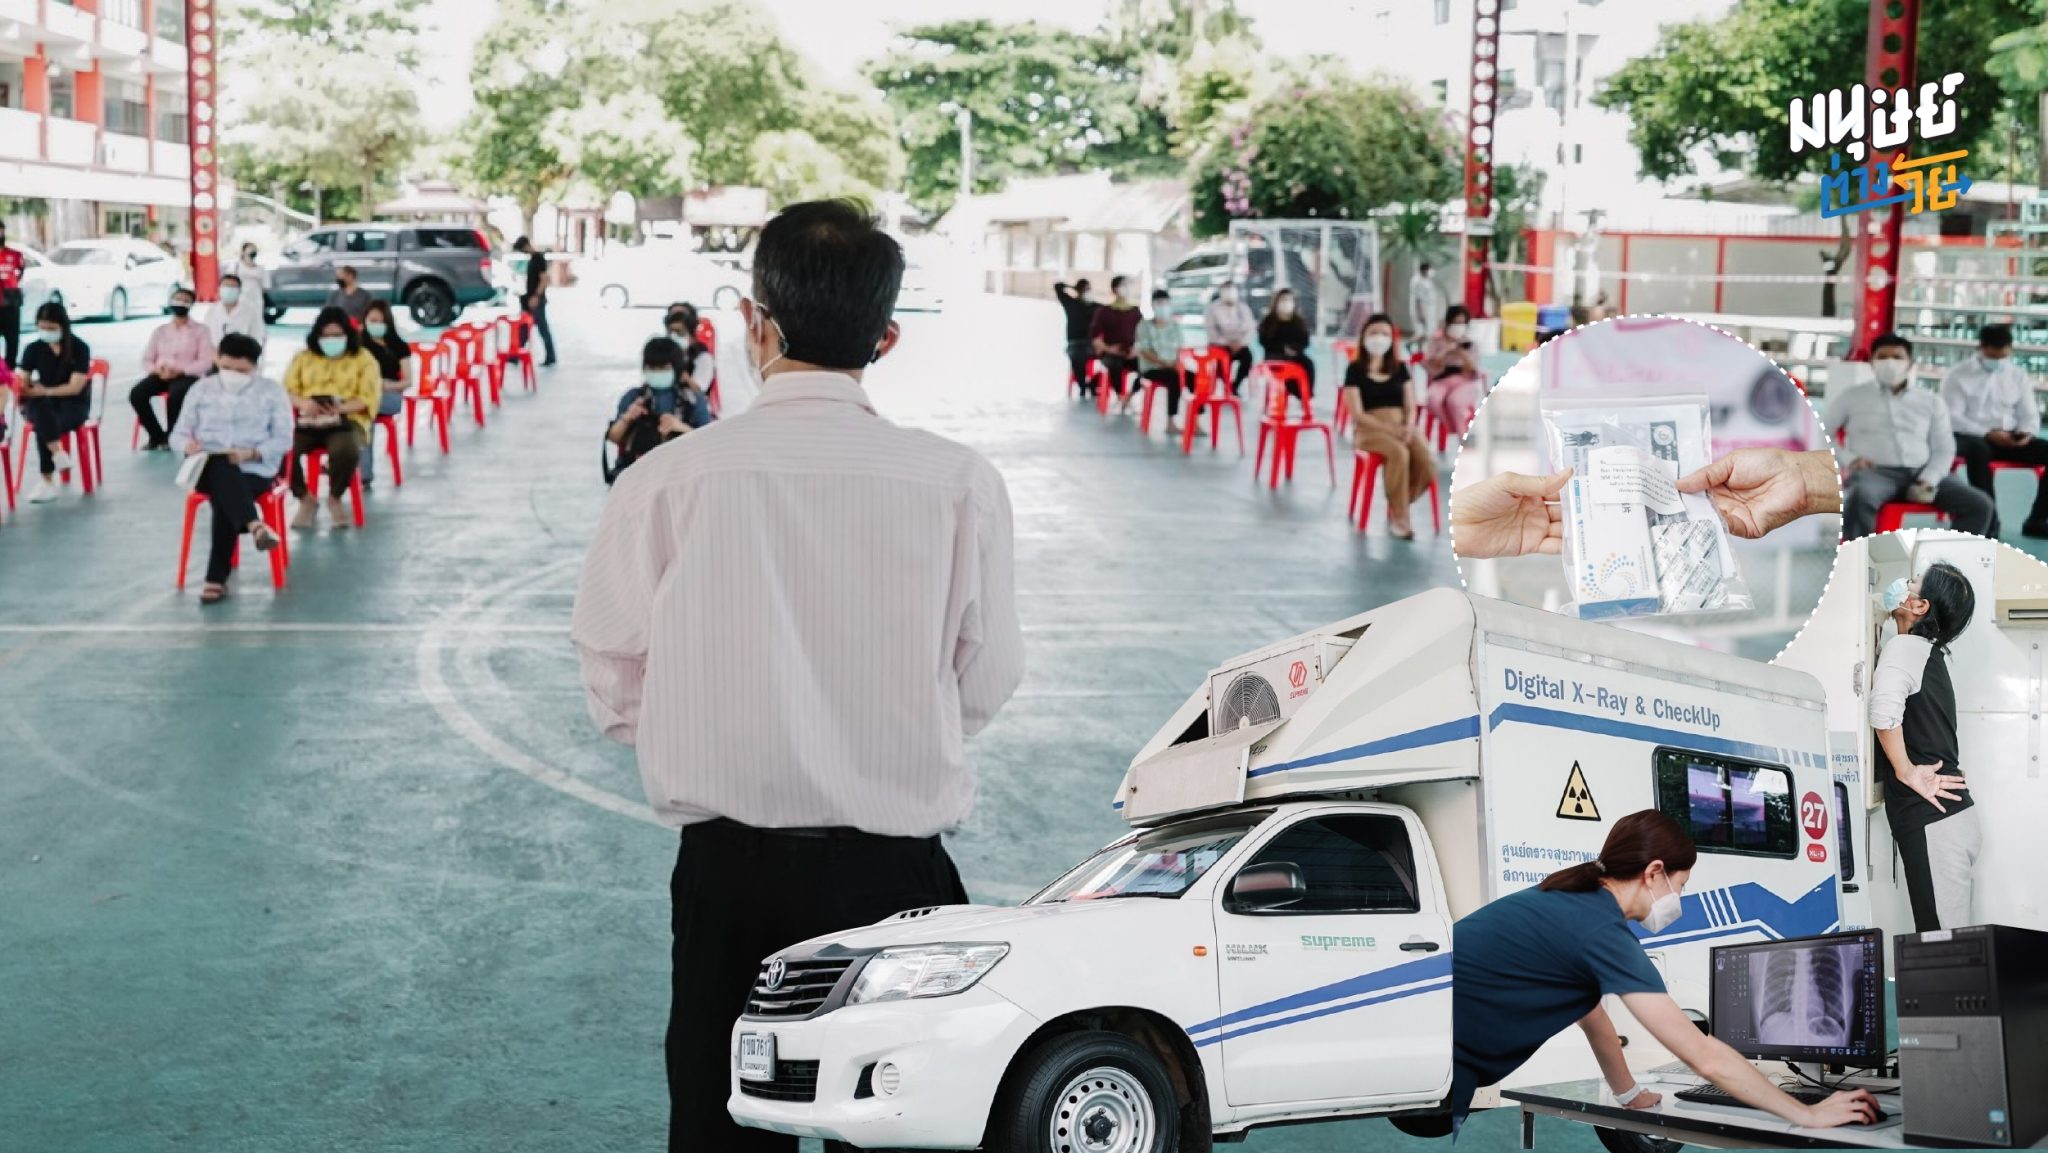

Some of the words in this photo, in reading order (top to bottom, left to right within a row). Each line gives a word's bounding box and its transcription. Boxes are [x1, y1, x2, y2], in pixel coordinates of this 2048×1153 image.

[1504, 668, 1564, 700] Digital
[1572, 681, 1628, 716] X-Ray
[1635, 695, 1646, 716] &
[1653, 698, 1720, 731] CheckUp
[1803, 801, 1825, 829] 27
[1301, 935, 1377, 951] supreme
